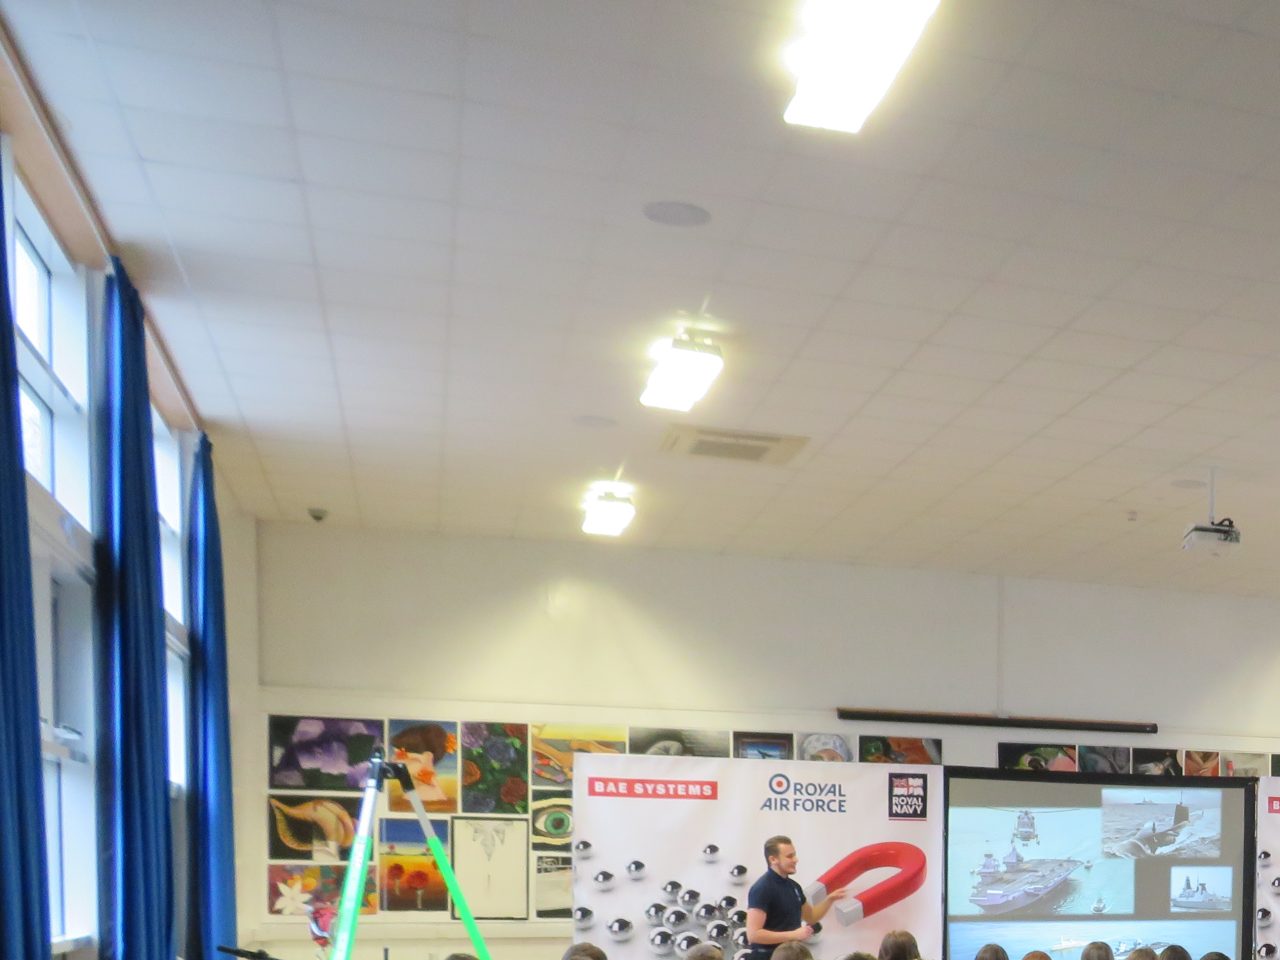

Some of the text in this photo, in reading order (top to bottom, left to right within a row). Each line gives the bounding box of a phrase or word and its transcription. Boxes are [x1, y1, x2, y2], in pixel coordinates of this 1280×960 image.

[594, 781, 713, 796] BAE SYSTEMS
[793, 782, 846, 797] ROYAL
[760, 797, 847, 813] AIR FORCE
[892, 797, 923, 806] ROYAL
[892, 804, 922, 814] NAVY
